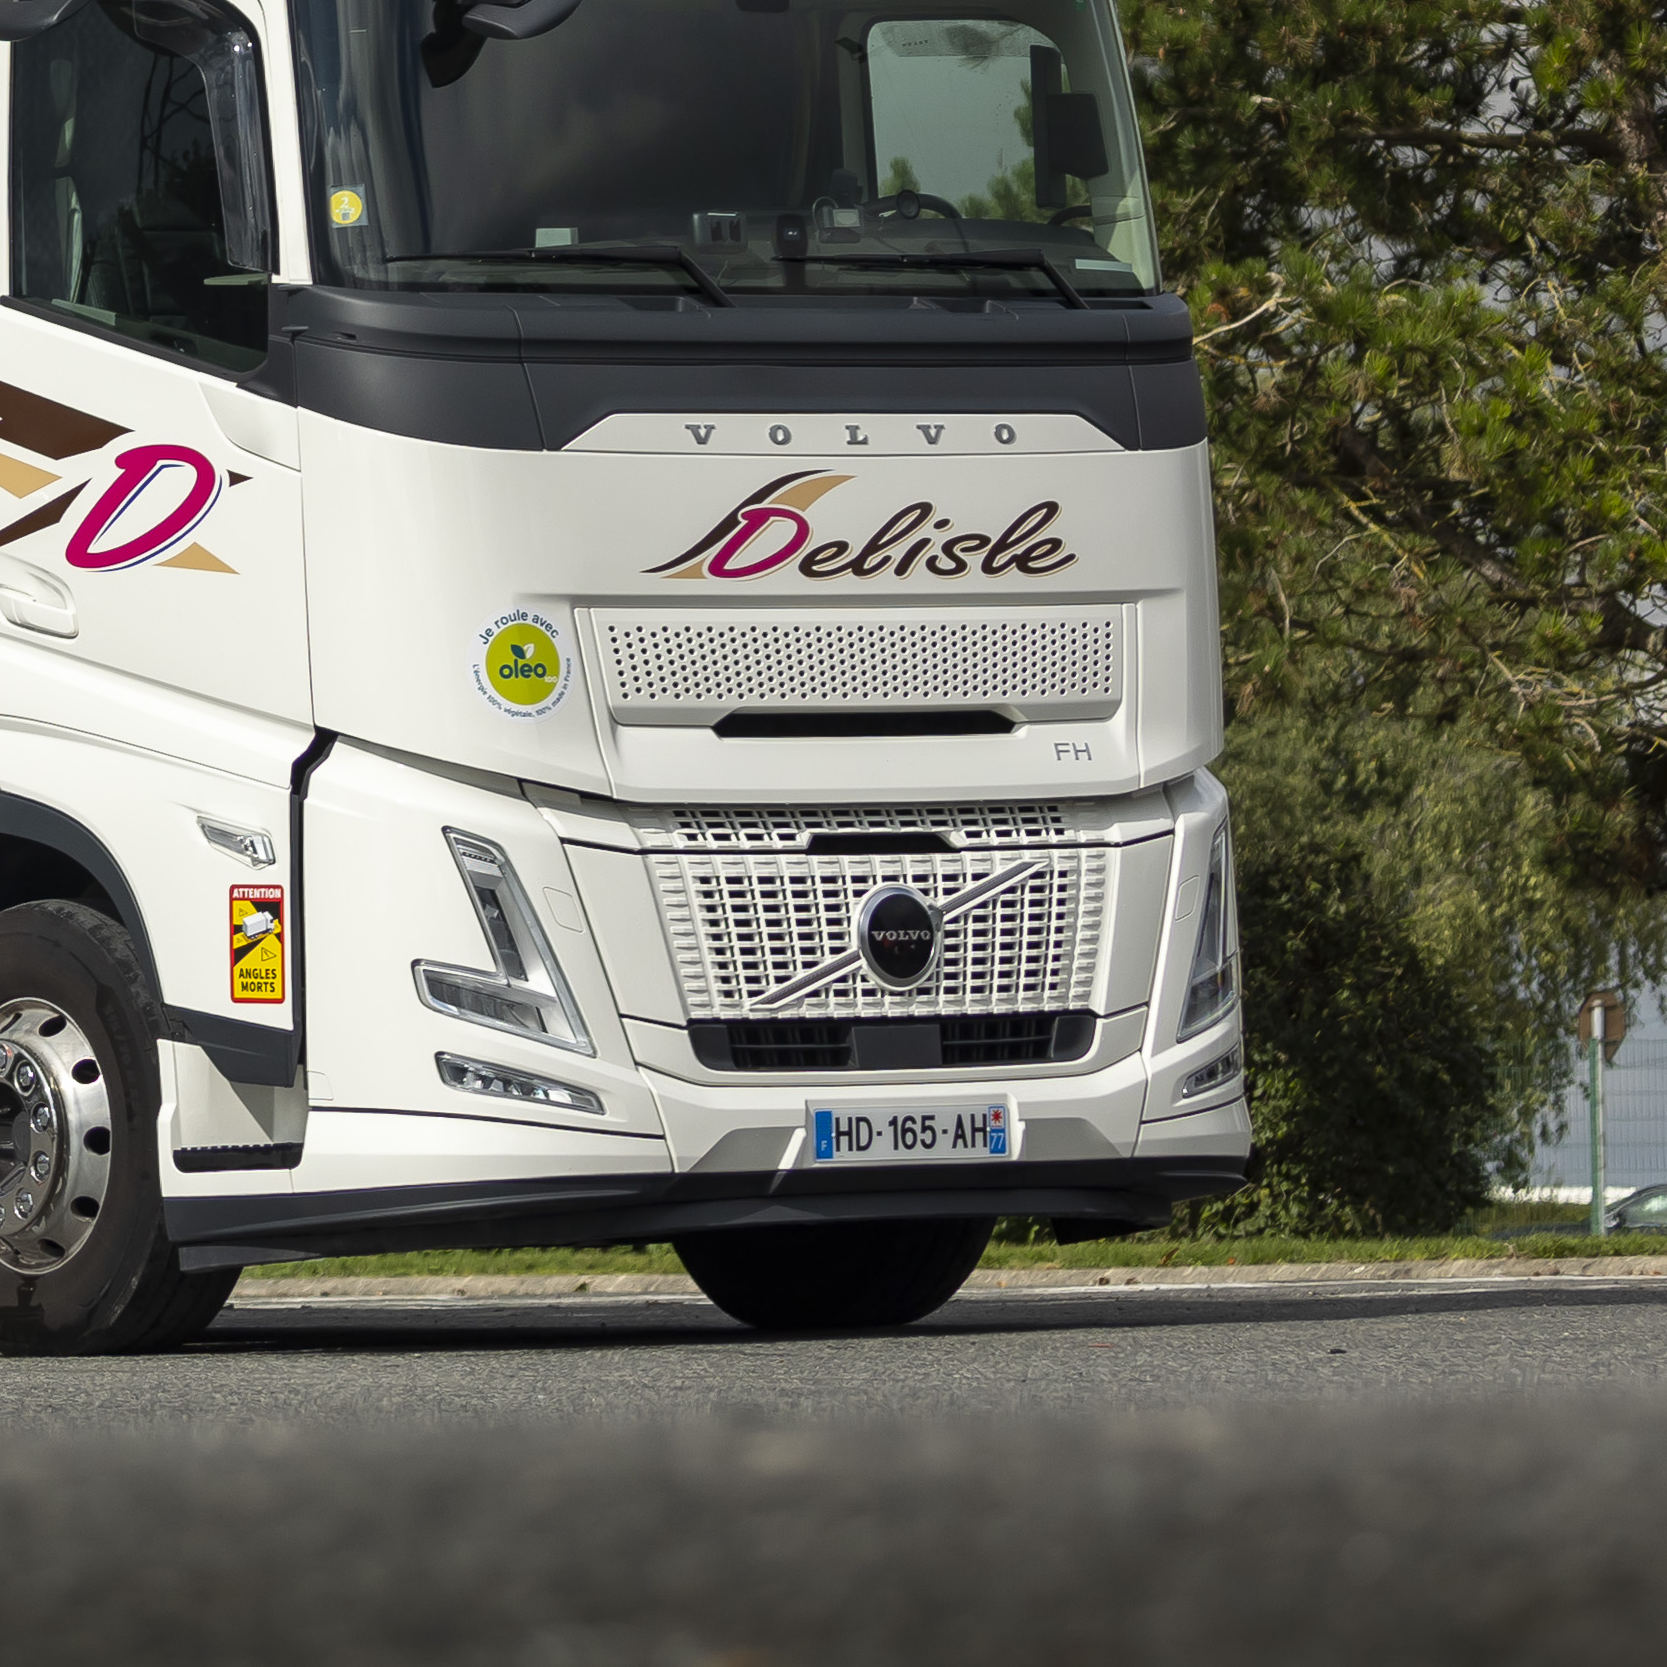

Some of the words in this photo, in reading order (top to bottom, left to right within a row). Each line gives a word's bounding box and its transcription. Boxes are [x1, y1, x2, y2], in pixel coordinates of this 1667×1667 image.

[685, 423, 1018, 446] VOLVO
[65, 444, 223, 573] D
[706, 499, 1079, 582] Delisle
[479, 628, 495, 645] Je
[494, 609, 528, 629] roule
[532, 614, 559, 639] avec
[499, 658, 547, 679] oleo
[1054, 742, 1093, 762] FH
[232, 888, 281, 899] ATTENTION
[871, 930, 931, 941] VOLVO
[238, 968, 277, 979] ANGLES
[241, 982, 275, 993] MORTS
[835, 1113, 988, 1153] HD-165-AH
[990, 1132, 1004, 1150] 77
[821, 1140, 828, 1151] F
